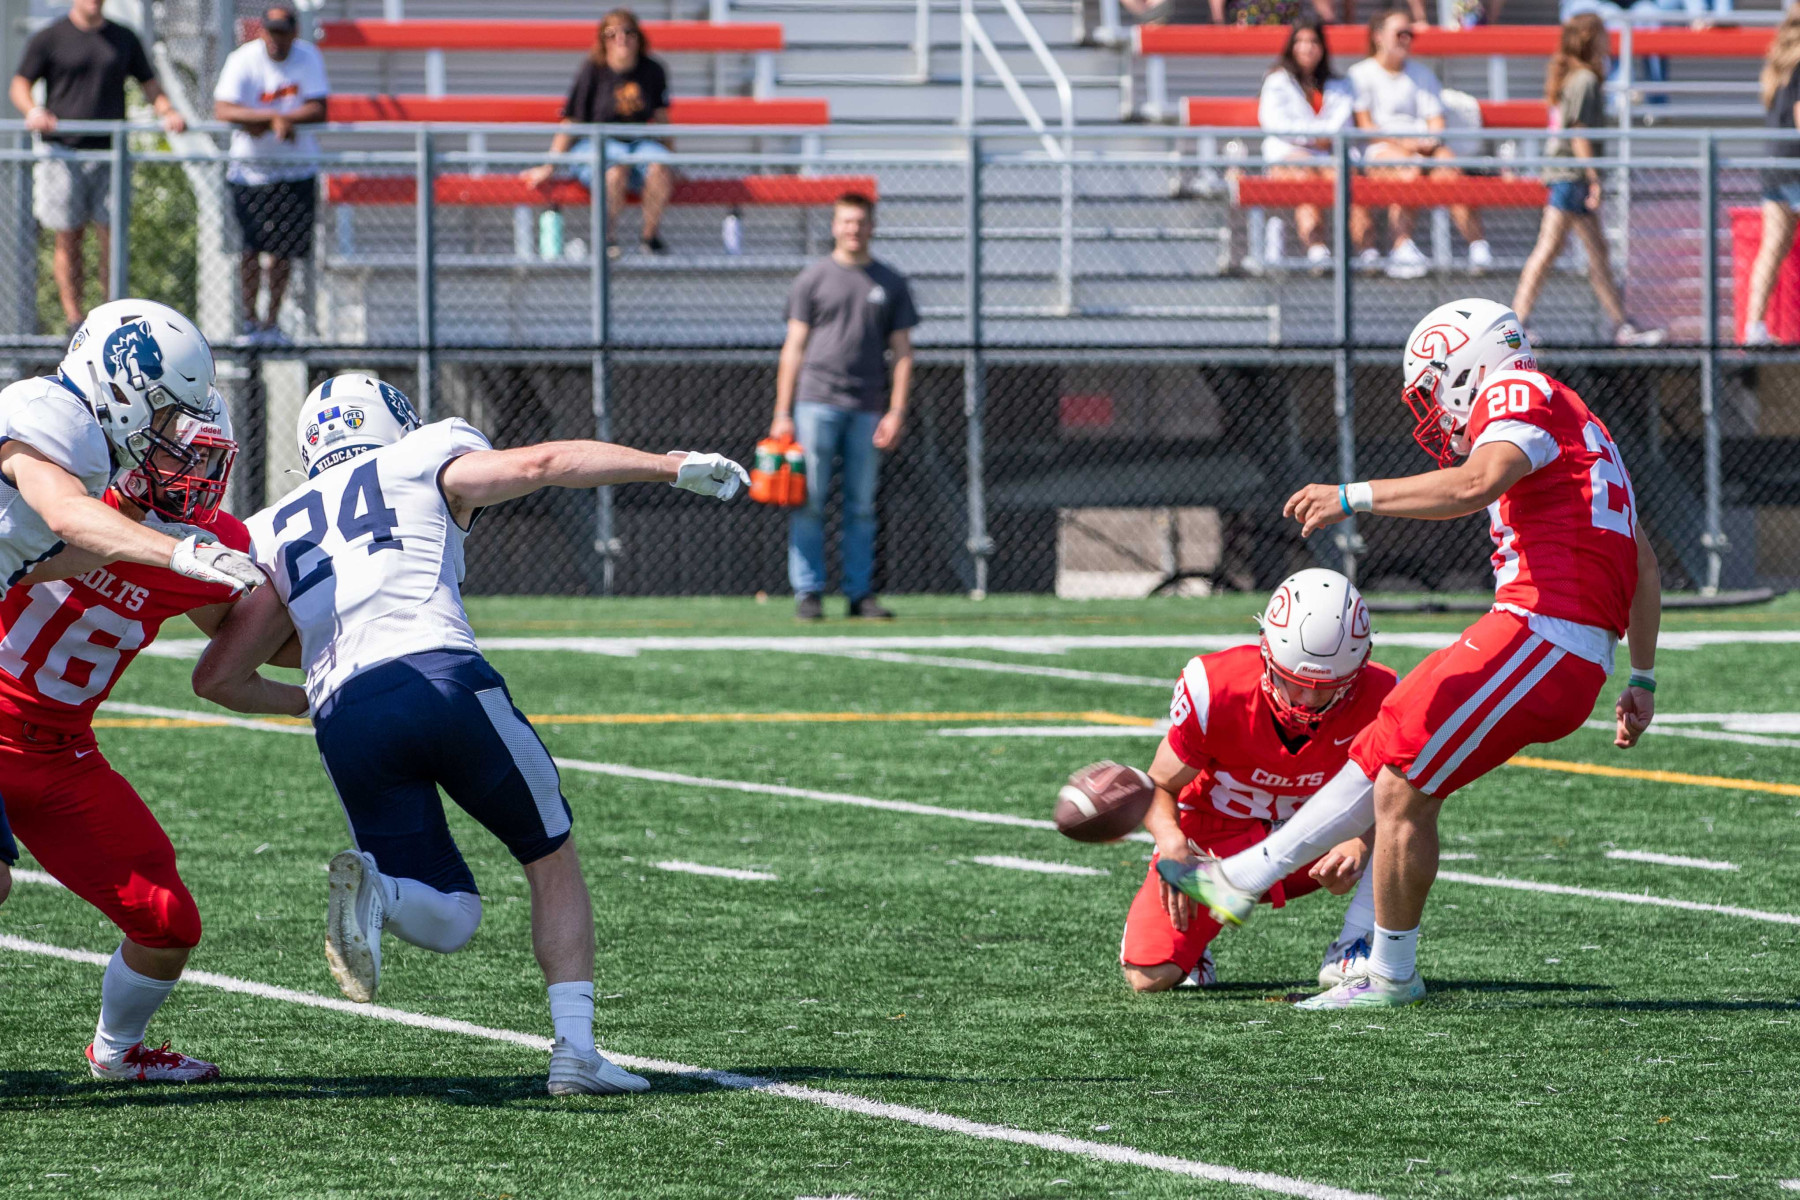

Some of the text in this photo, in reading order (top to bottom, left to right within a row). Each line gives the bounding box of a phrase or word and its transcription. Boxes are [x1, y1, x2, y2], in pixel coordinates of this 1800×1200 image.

[1514, 357, 1537, 369] Ridd
[1486, 383, 1530, 419] 20
[272, 458, 404, 603] 24
[1169, 677, 1191, 727] 86
[1251, 767, 1325, 788] COLTS
